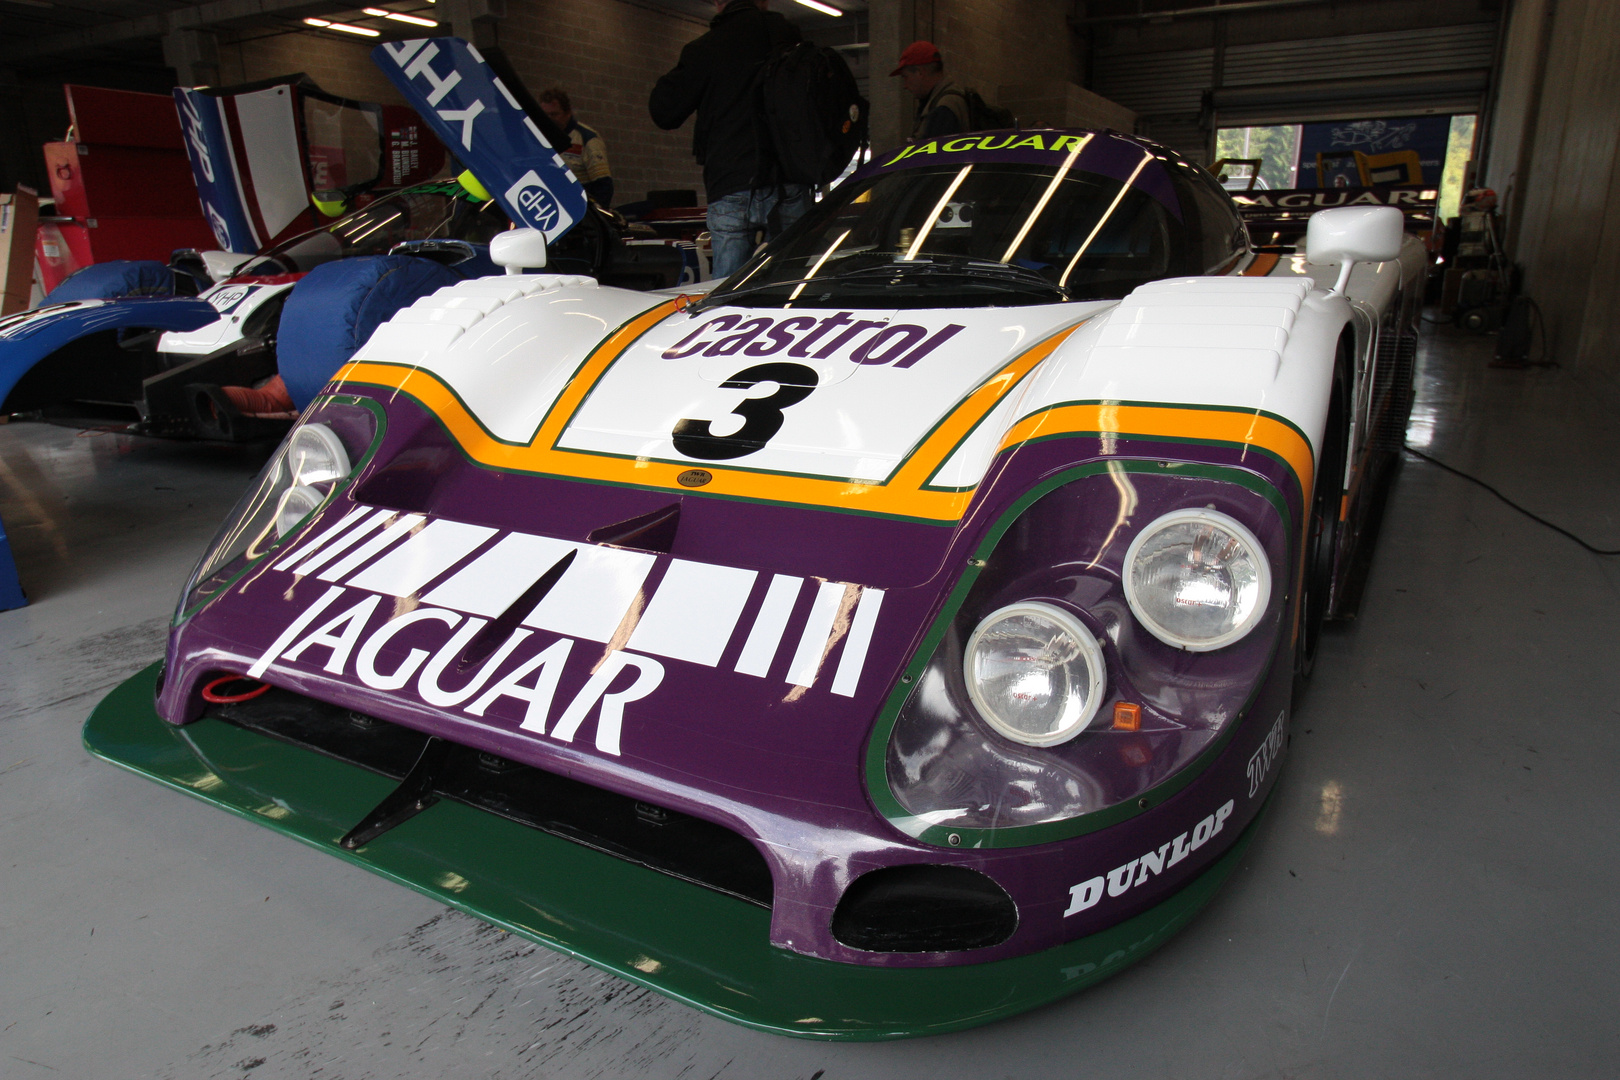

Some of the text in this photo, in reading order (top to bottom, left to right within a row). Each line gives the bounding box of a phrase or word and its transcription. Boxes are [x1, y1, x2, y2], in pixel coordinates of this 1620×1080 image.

[410, 149, 418, 169] BAILEY
[881, 134, 1087, 168] JAGUAR
[517, 188, 558, 231] YHP
[210, 291, 244, 306] YHP
[672, 362, 820, 461] 3
[246, 585, 666, 757] JAGUAR
[1063, 798, 1235, 919] DUNLOP
